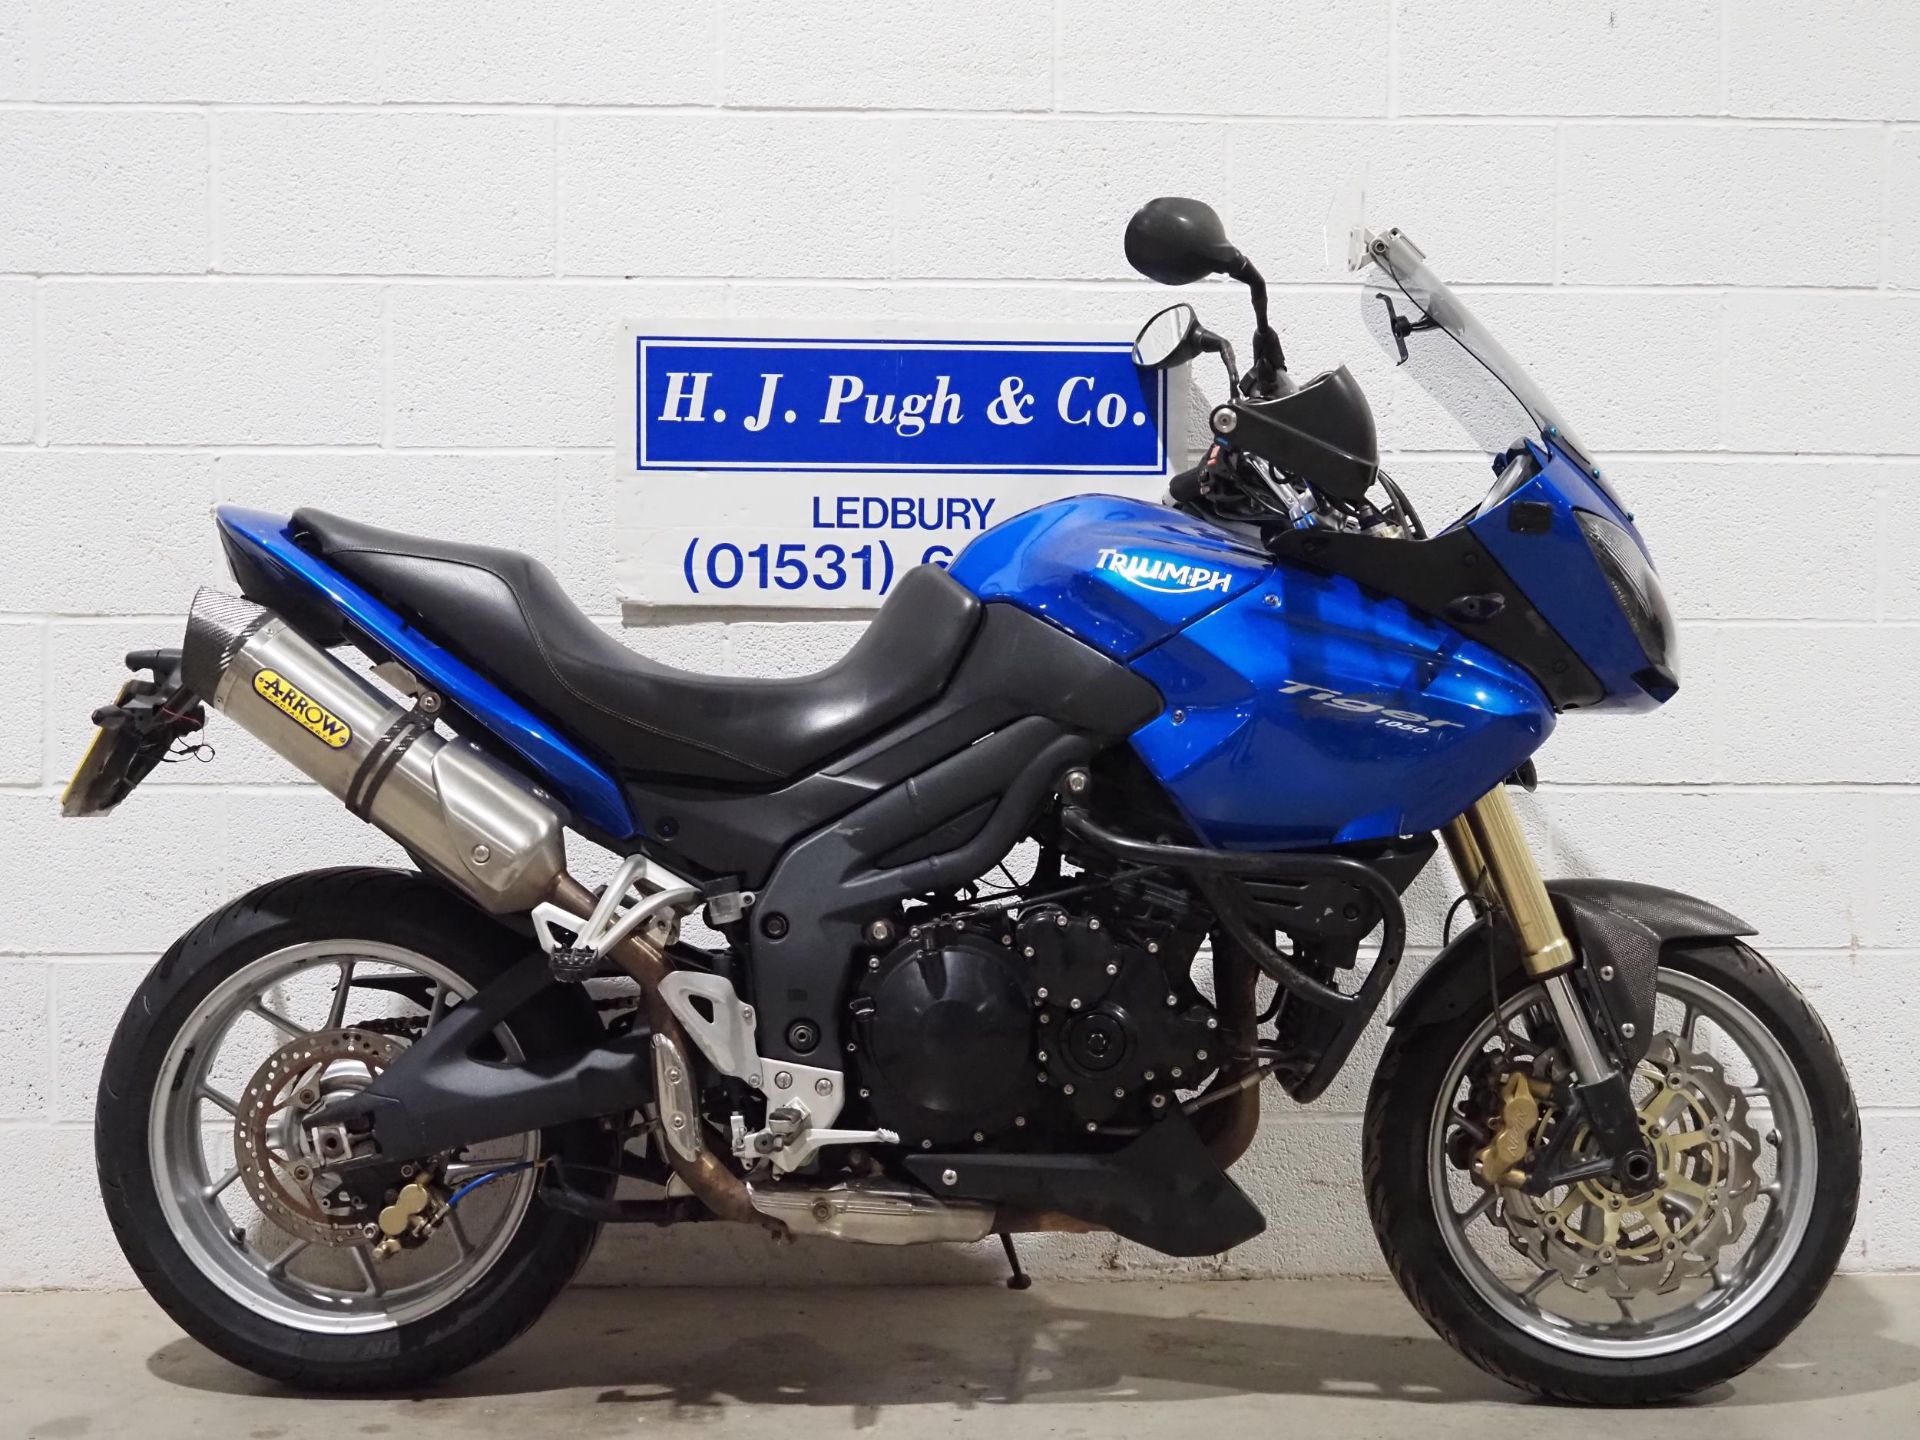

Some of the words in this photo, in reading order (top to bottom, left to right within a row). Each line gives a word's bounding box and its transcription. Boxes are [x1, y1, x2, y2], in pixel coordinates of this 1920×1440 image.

[657, 372, 727, 423] H.
[743, 373, 797, 432] J.
[819, 375, 964, 437] Pugh
[986, 376, 1035, 426] &
[1057, 376, 1146, 428] Co.
[812, 496, 996, 531] LEDBURY
[683, 537, 894, 596] (01531)
[1096, 548, 1232, 593] TRIUMPH
[263, 678, 345, 737] ARROW
[1278, 679, 1465, 728] Tiger
[1374, 718, 1430, 734] 1050
